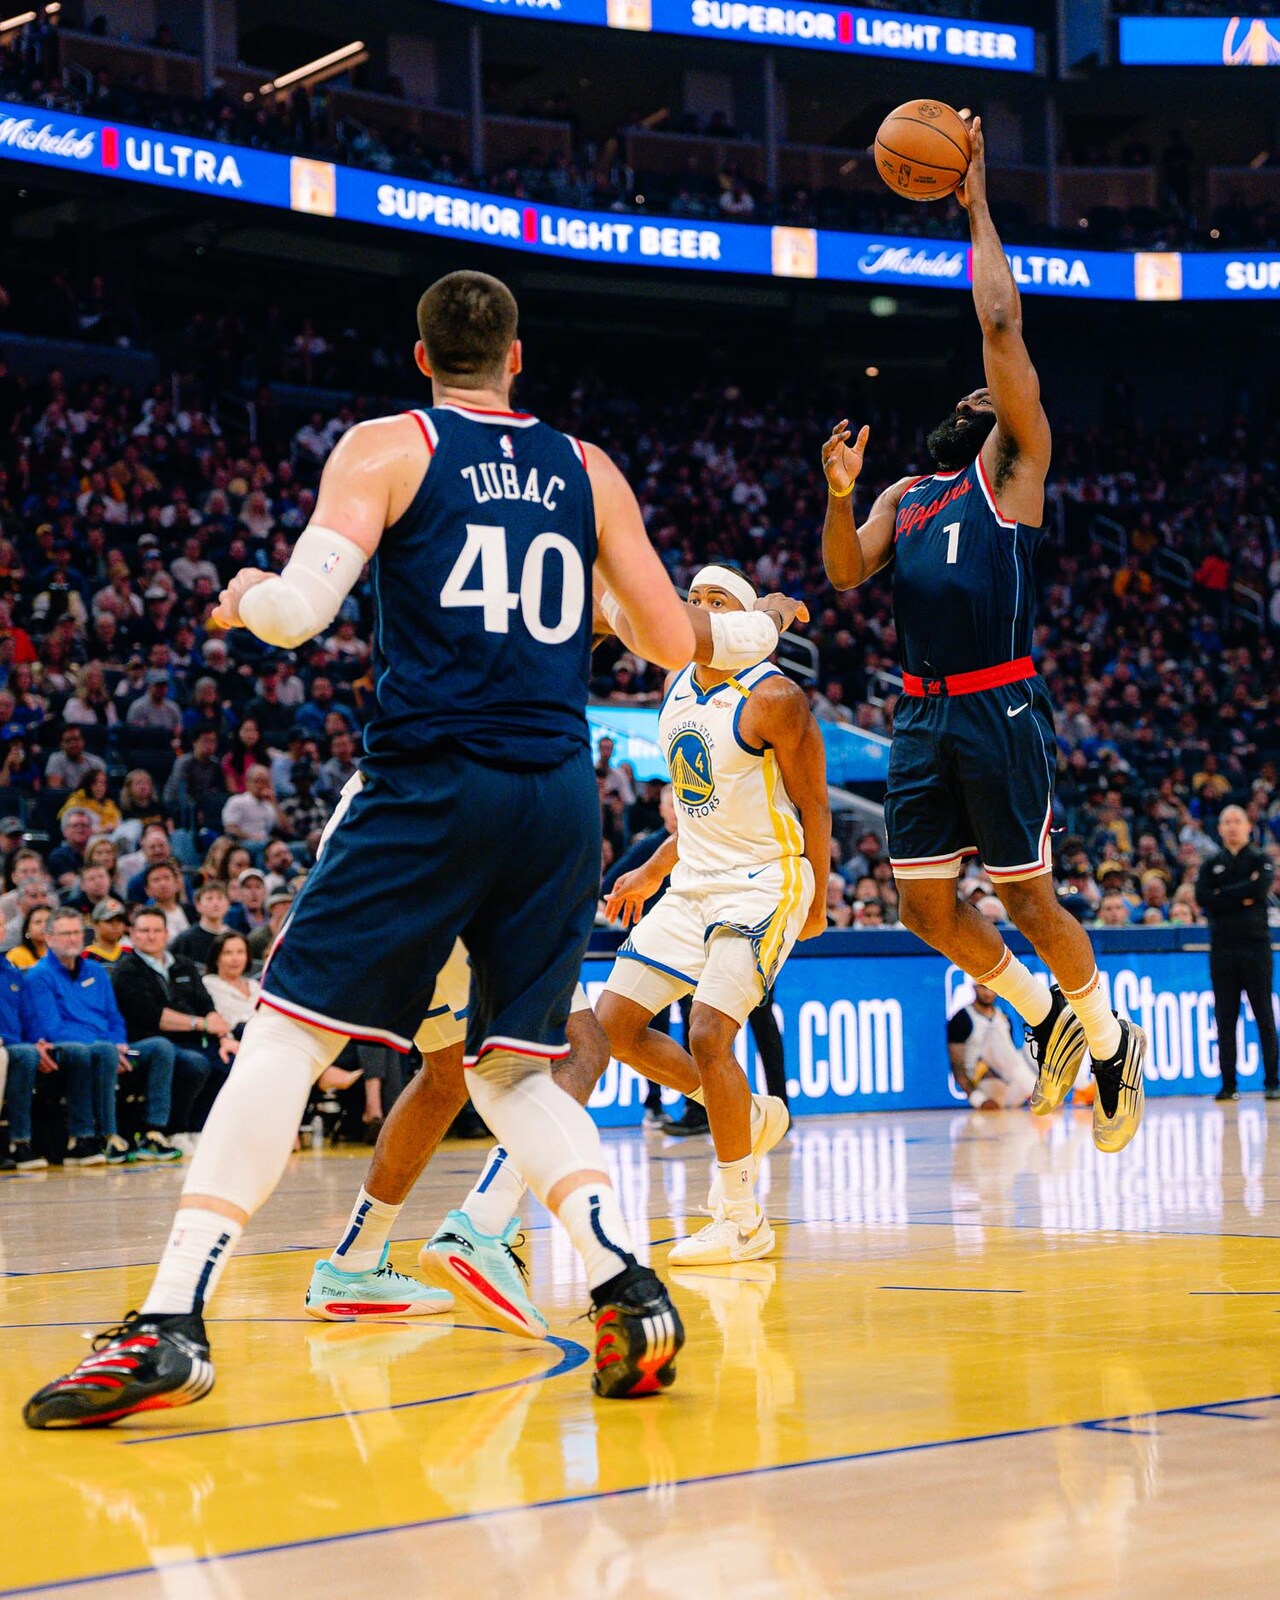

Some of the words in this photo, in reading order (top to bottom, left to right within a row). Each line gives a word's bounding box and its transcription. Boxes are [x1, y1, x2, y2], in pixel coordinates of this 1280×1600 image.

[692, 0, 836, 40] SUPERIOR
[856, 17, 941, 51] LIGHT
[946, 27, 1017, 60] BEER
[0, 114, 96, 159] Michelob
[125, 137, 243, 188] ULTRA
[377, 184, 521, 240] SUPERIOR
[541, 214, 633, 253] LIGHT
[639, 225, 722, 261] BEER
[1005, 254, 1091, 288] LTRA
[461, 463, 565, 511] ZUBAC
[942, 522, 960, 564] 1
[440, 524, 585, 644] 40
[668, 720, 697, 741] GOLDEN
[699, 724, 716, 750] STATE
[695, 752, 704, 773] 4
[679, 795, 721, 818] RIORS
